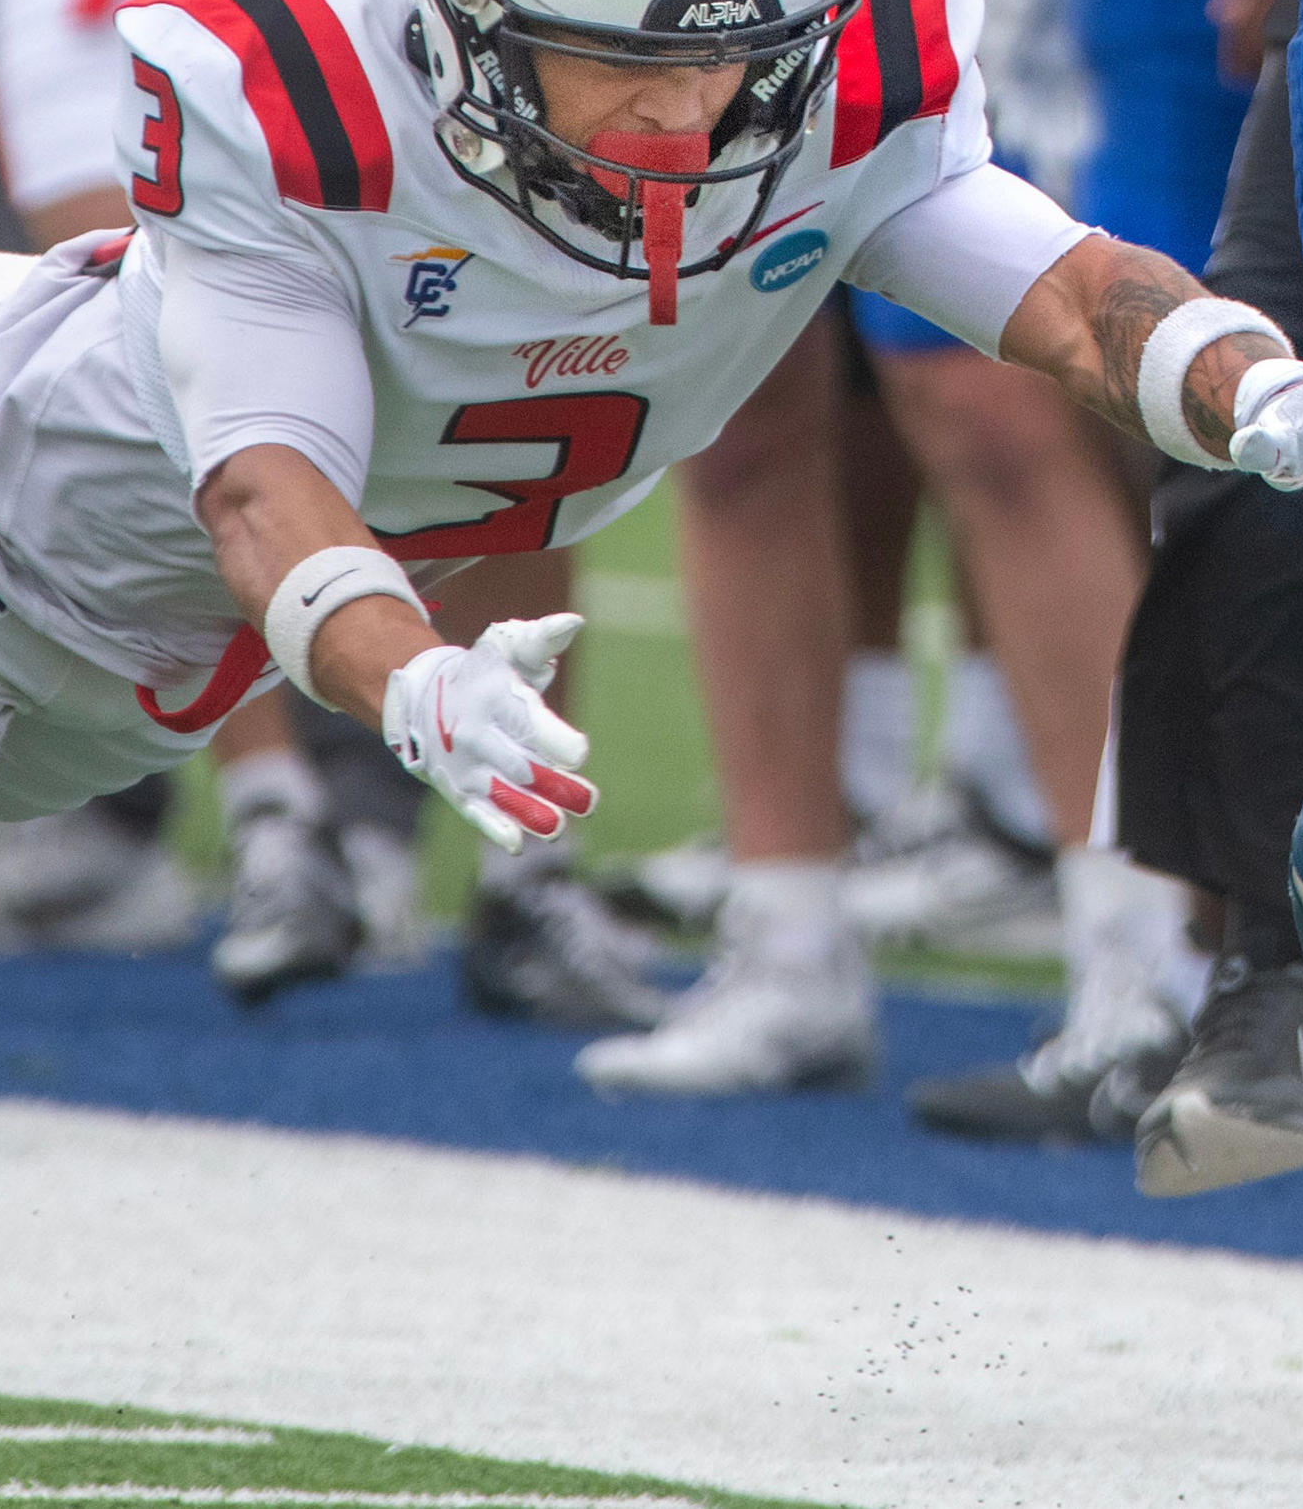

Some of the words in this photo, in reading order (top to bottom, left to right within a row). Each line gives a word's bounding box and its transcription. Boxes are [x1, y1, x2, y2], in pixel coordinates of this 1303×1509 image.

[130, 52, 184, 218] 3
[761, 247, 824, 286] NCAA
[524, 335, 630, 389] Ville
